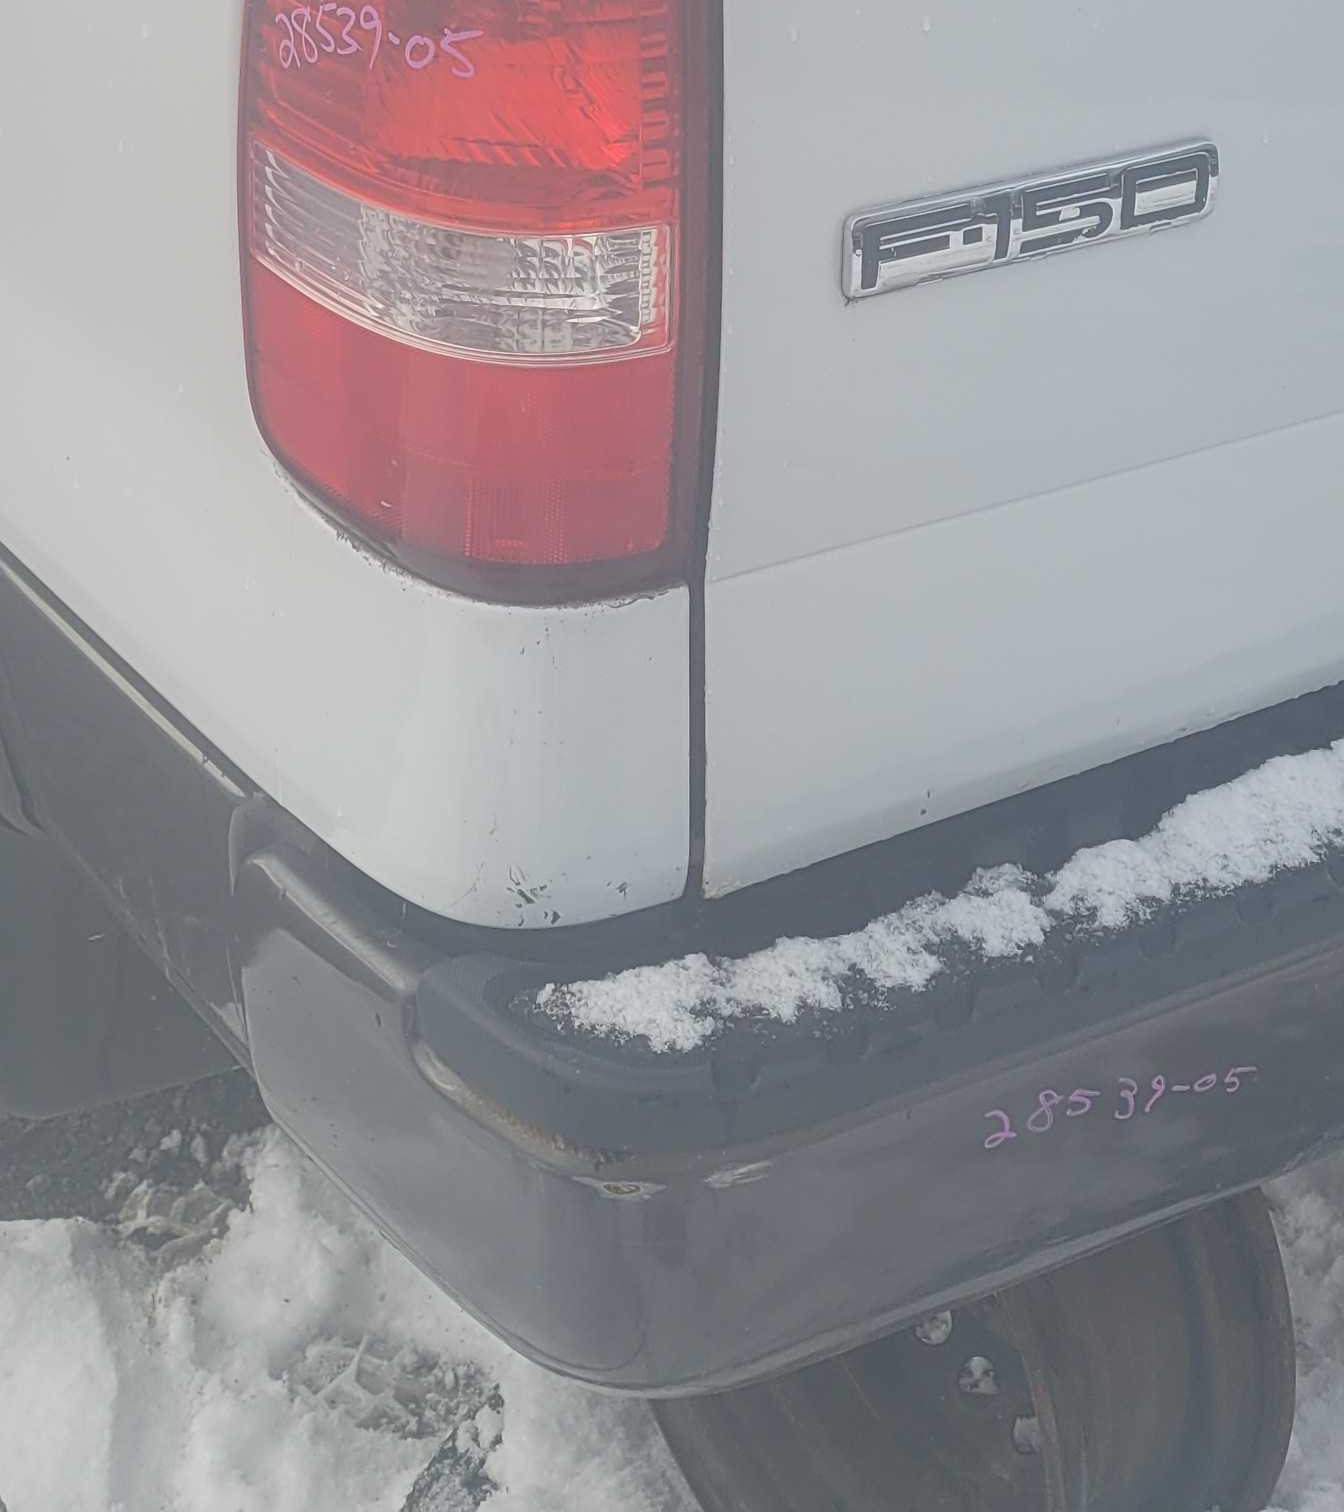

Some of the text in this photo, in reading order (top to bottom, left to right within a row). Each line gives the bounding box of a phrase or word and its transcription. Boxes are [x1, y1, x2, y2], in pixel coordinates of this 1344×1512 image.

[275, 1, 485, 78] 28539-05
[860, 151, 1210, 290] F-150
[984, 1066, 1257, 1148] 28539-05
